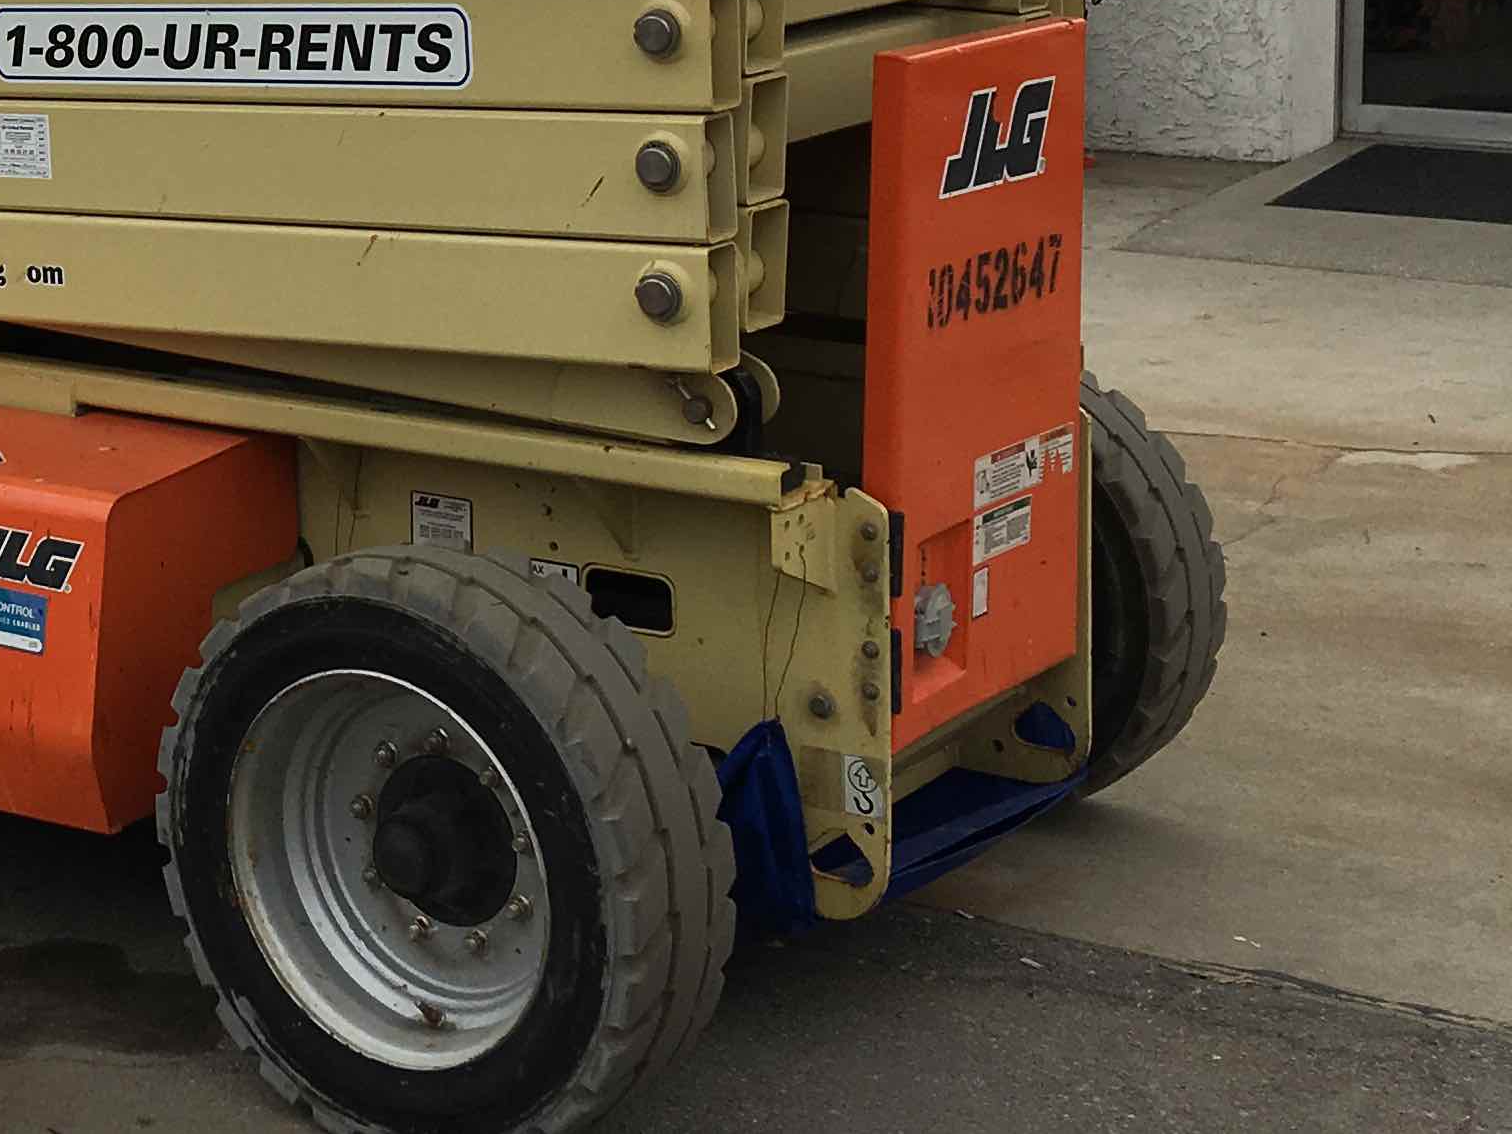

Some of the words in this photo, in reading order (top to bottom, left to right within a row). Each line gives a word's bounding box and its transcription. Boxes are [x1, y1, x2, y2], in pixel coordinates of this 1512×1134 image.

[5, 22, 453, 73] 1-800-UR-RENTS
[939, 76, 1056, 199] JLG
[927, 233, 1062, 330] 10452647
